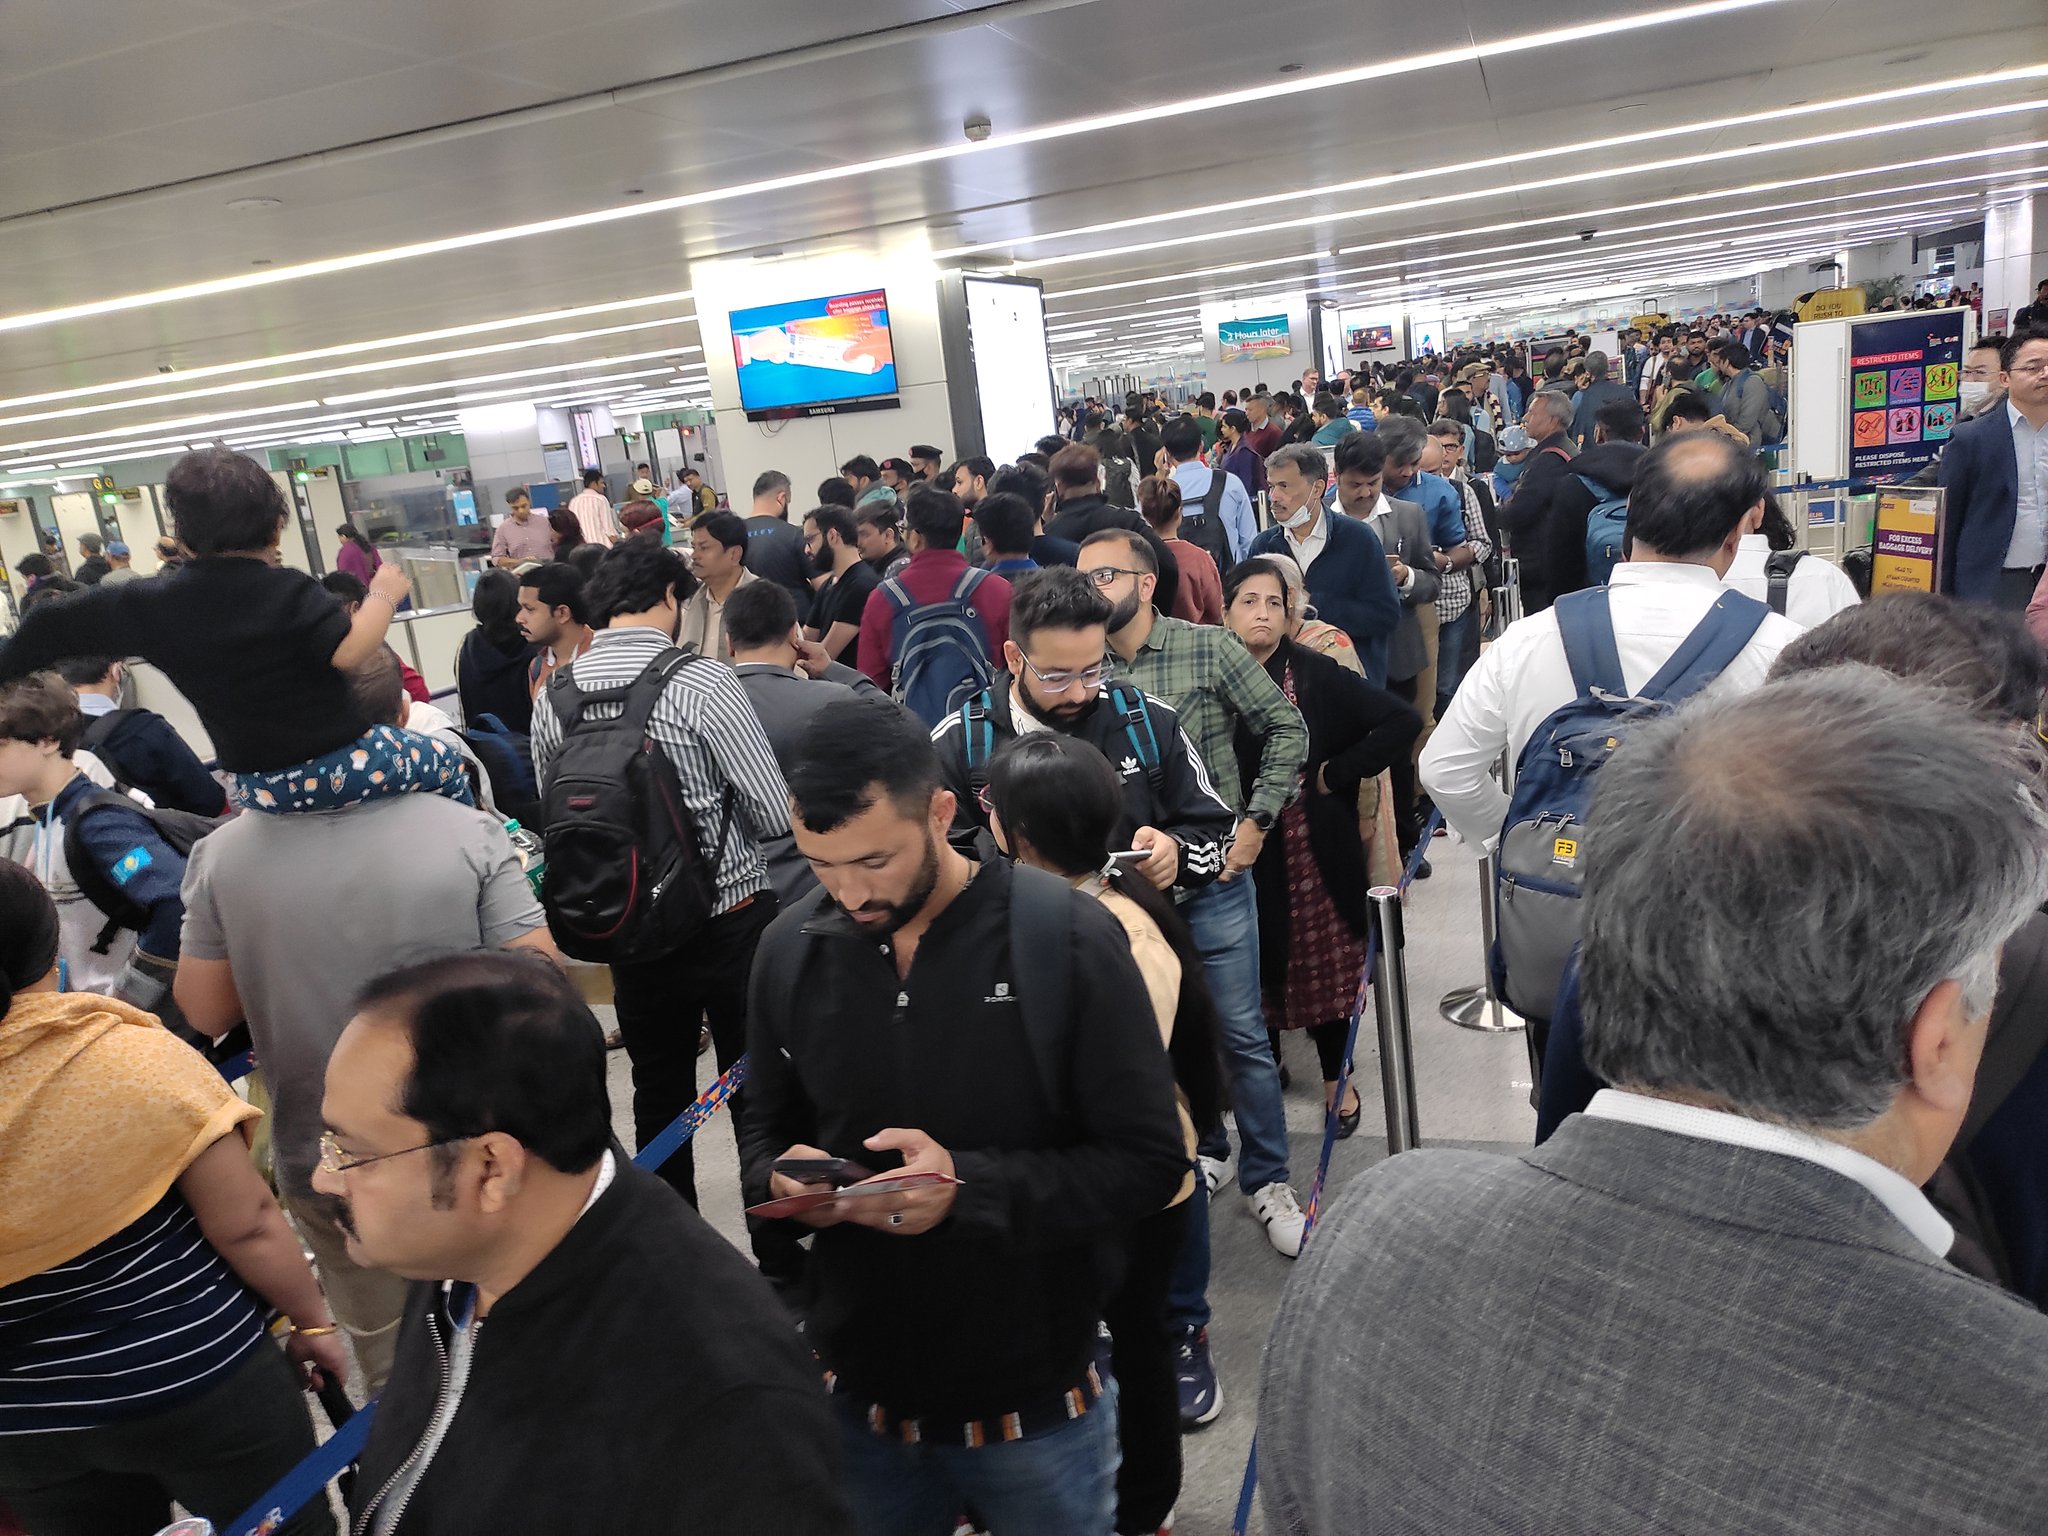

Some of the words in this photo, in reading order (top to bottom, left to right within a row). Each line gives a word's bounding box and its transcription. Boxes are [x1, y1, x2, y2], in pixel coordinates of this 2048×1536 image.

[1227, 332, 1234, 341] 2
[1259, 328, 1280, 338] later
[1856, 355, 1897, 365] RESTRICTED
[1898, 351, 1919, 360] ITEMS
[1855, 453, 1878, 462] PLEASE
[1878, 451, 1905, 460] DISPOSE
[1855, 459, 1892, 468] RESTRICTED
[1892, 457, 1912, 465] ITEMS
[1912, 455, 1929, 463] HERE
[1888, 533, 1901, 542] FOR
[1901, 535, 1922, 544] EXCESS
[1878, 541, 1905, 552] BAGGAGE
[1905, 545, 1934, 555] DELIVERY
[1122, 766, 1140, 776] adidas
